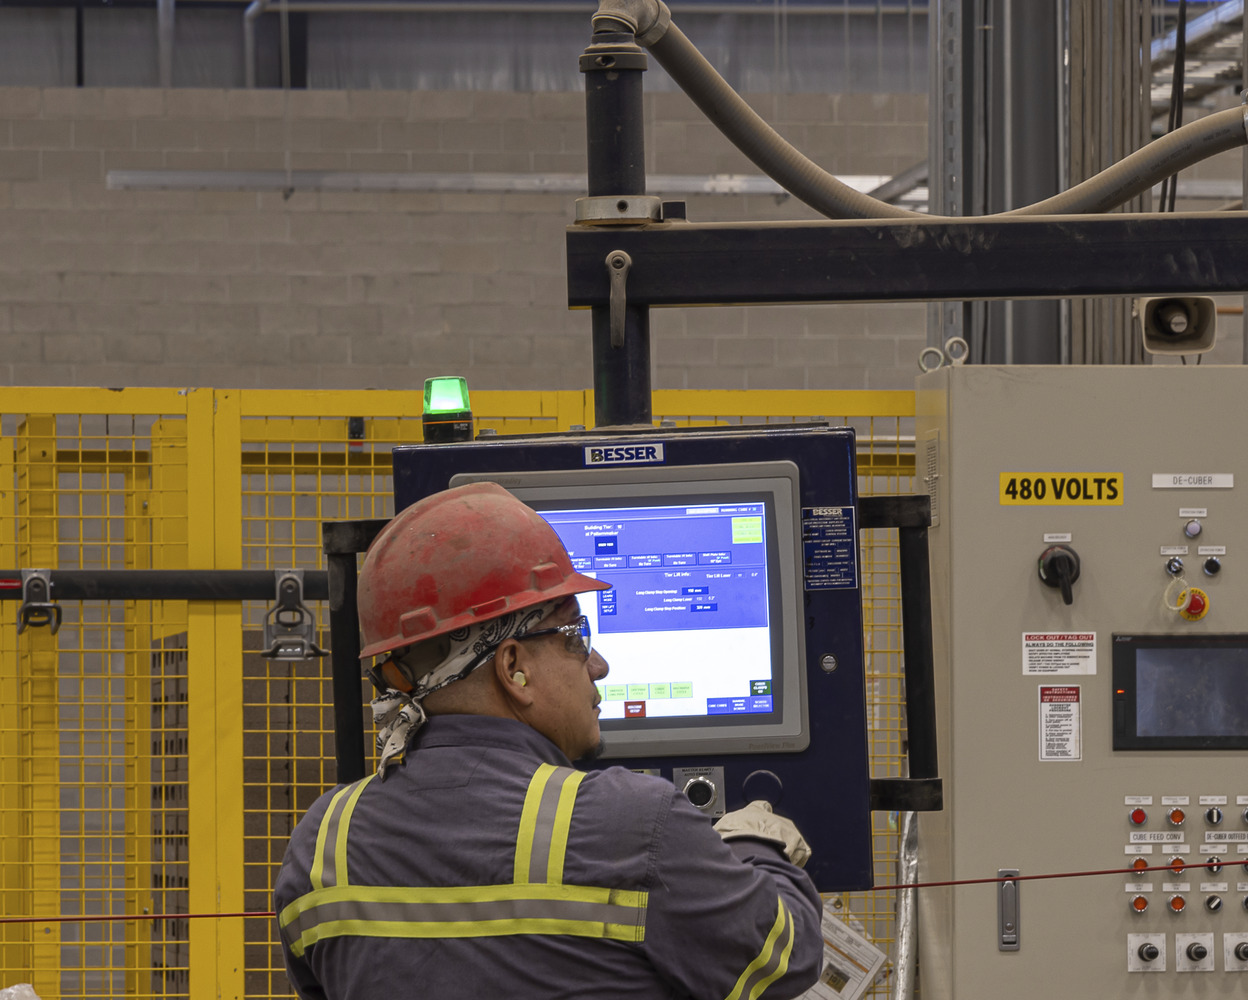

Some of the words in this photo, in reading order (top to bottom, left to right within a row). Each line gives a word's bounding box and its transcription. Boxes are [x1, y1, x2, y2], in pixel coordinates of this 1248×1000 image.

[591, 446, 657, 463] BESSER
[1173, 476, 1213, 485] DE-CUBER
[1005, 478, 1046, 500] 480
[1051, 478, 1118, 500] VOLTS
[812, 508, 842, 516] BESSER
[1132, 833, 1147, 841] CUBE
[1149, 833, 1164, 841] FEED
[1166, 832, 1181, 840] CONV
